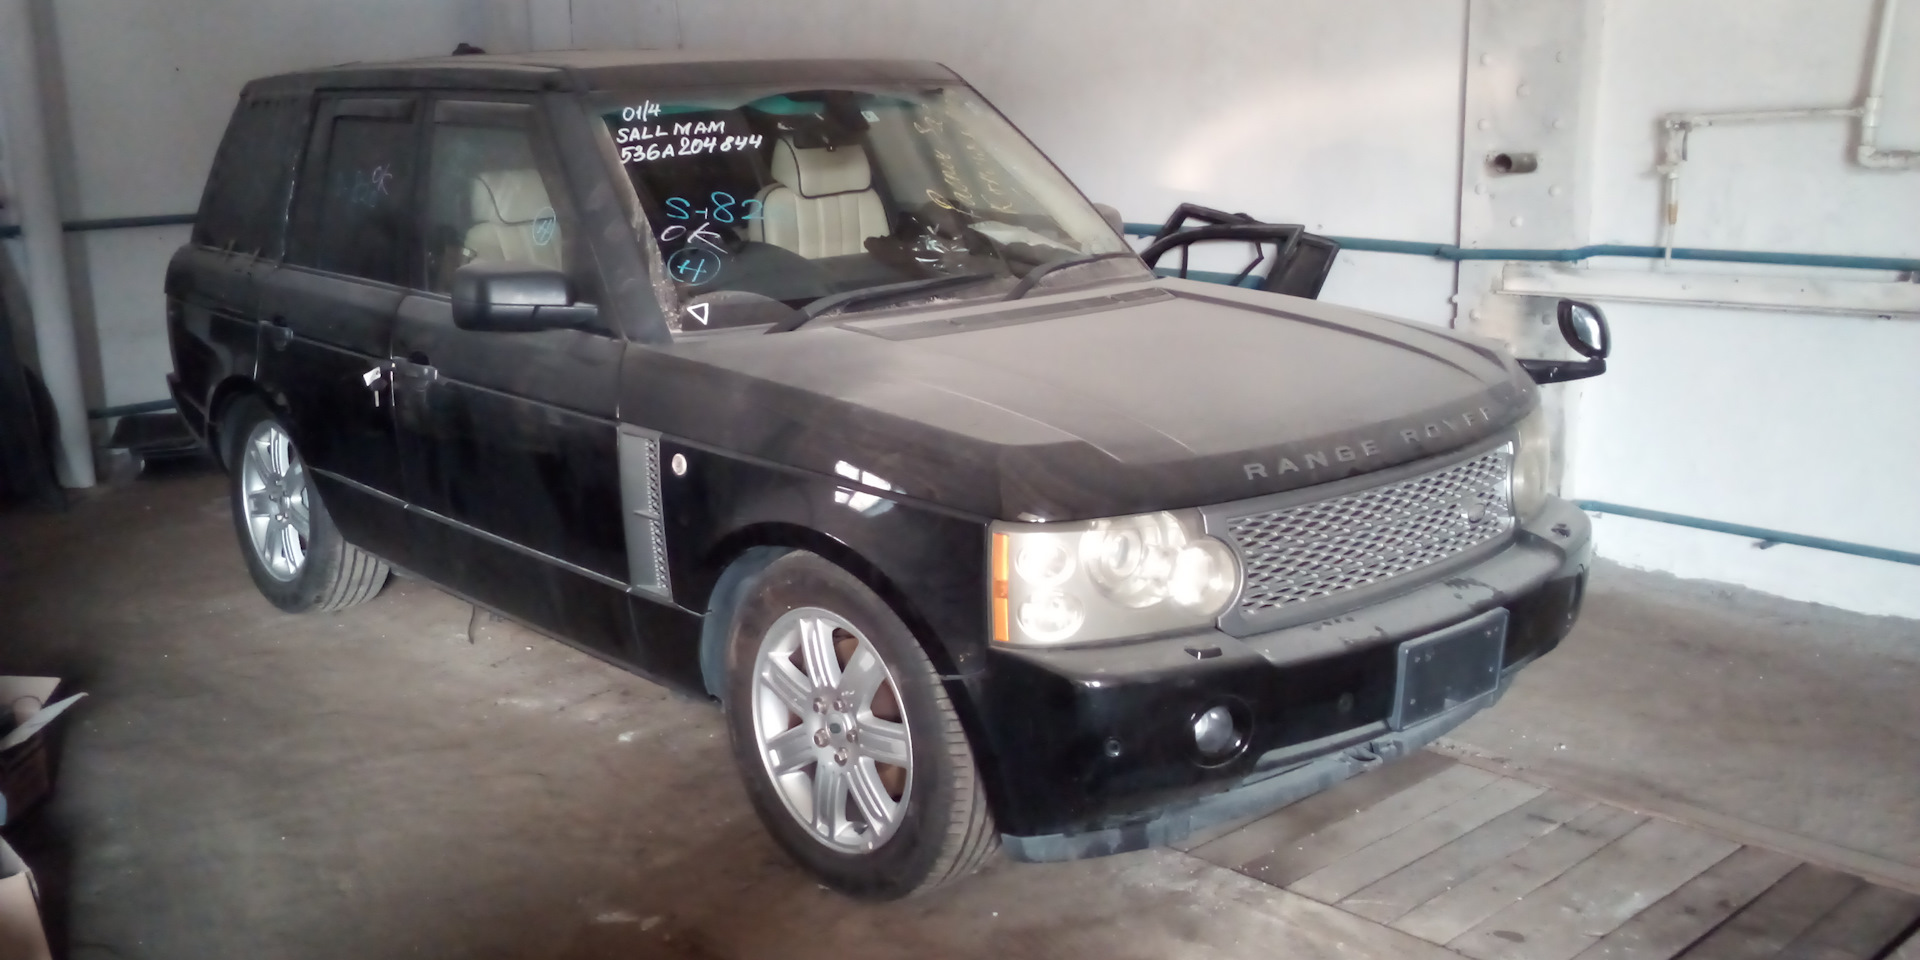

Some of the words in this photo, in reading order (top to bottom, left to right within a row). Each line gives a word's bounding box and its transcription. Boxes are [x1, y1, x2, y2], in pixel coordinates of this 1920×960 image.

[622, 100, 661, 122] 01/4
[616, 125, 669, 143] SALL
[673, 120, 725, 136] MAM
[1243, 439, 1378, 480] RANGE
